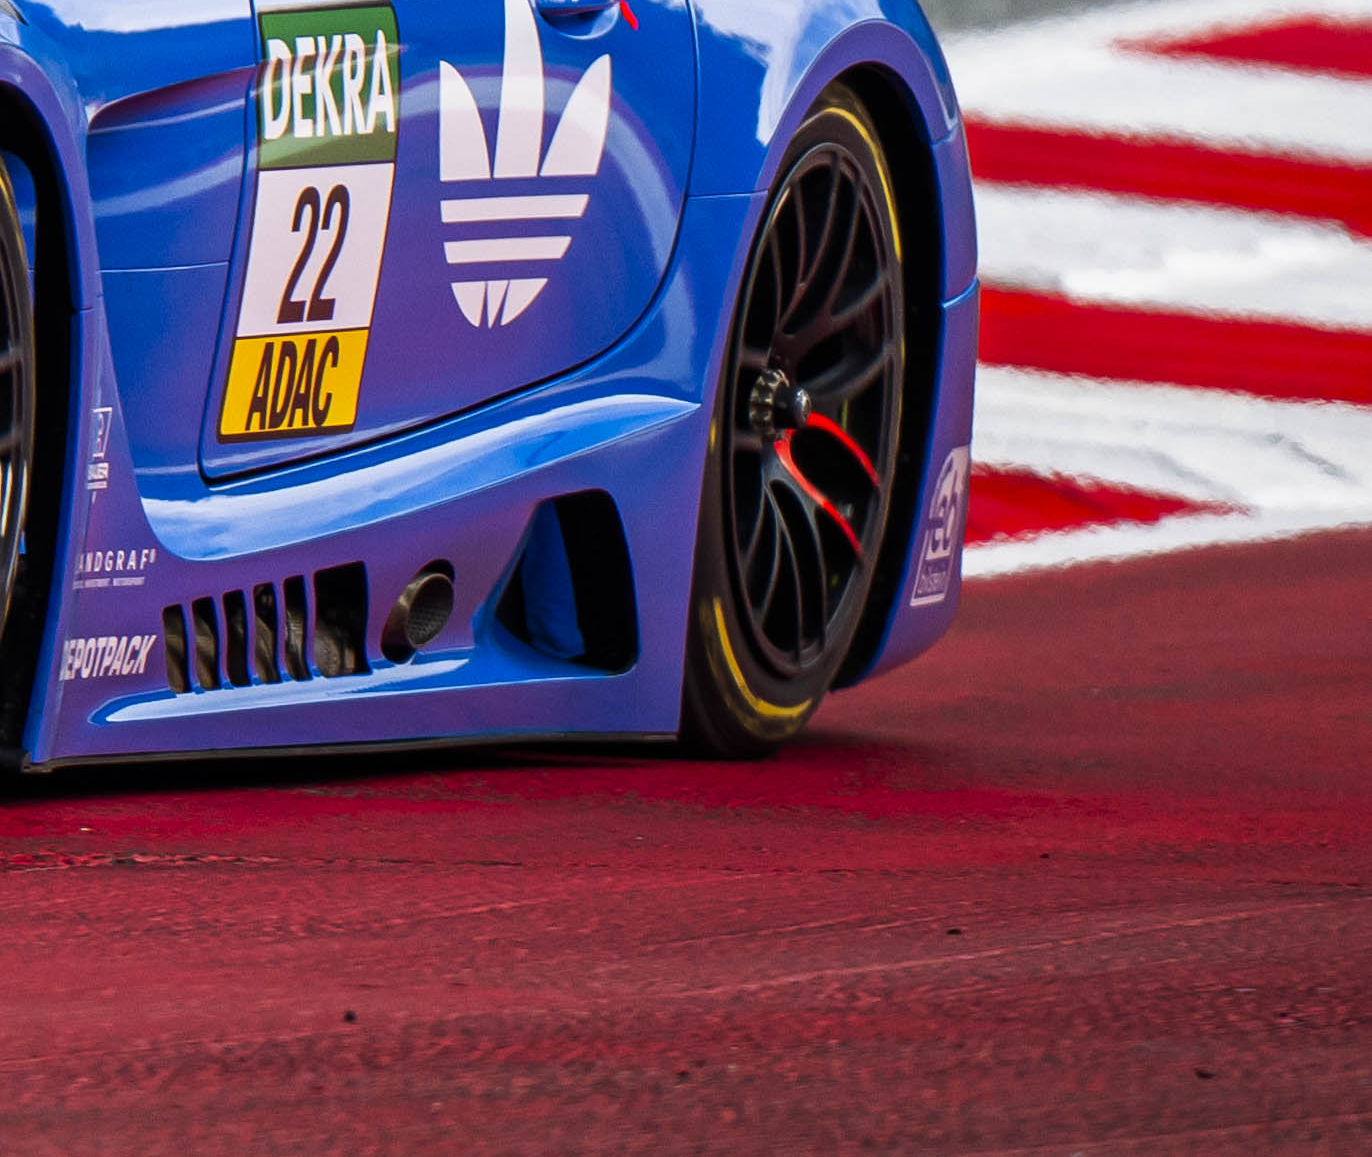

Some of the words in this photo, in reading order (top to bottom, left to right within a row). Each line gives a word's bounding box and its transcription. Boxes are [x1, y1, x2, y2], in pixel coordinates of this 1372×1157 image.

[263, 29, 396, 140] DEKRA
[277, 184, 350, 324] 22
[245, 336, 339, 431] ADAC
[74, 548, 149, 573] ANDGRAF
